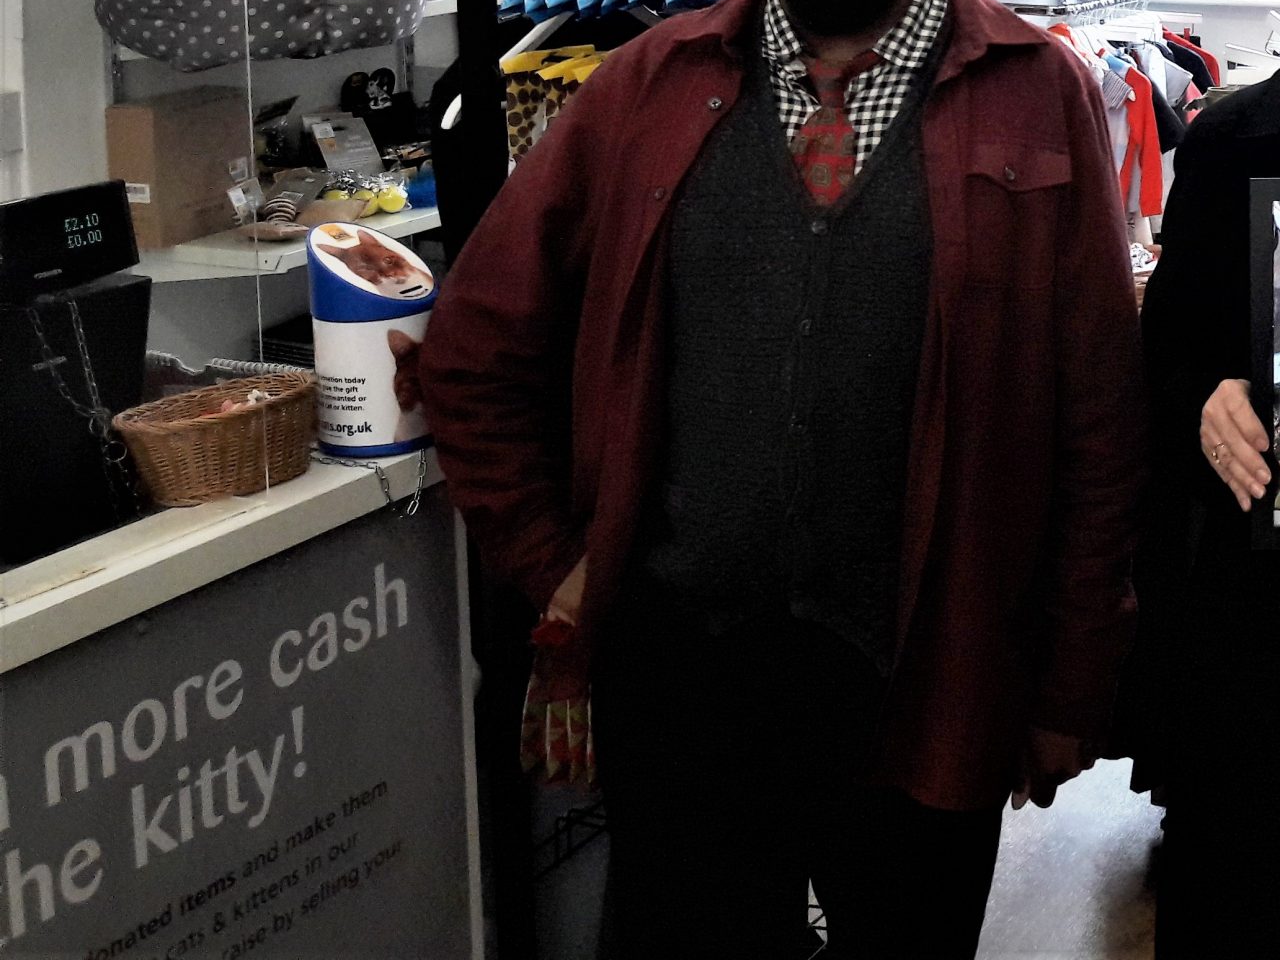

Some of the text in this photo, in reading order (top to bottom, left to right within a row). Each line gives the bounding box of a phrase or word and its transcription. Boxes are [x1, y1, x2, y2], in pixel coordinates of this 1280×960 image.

[65, 213, 98, 232] £2.10
[68, 230, 102, 248] £0.00
[344, 376, 366, 385] today
[345, 386, 359, 394] gift
[44, 658, 244, 808] more
[269, 562, 408, 689] cash
[0, 838, 104, 940] he
[130, 705, 308, 869] kitty!
[179, 870, 238, 917] items
[242, 841, 280, 880] and
[285, 810, 337, 855] make
[341, 779, 389, 818] them
[212, 912, 227, 934] &
[231, 870, 300, 921] kittens
[304, 854, 322, 876] in
[328, 830, 360, 862] our
[272, 908, 295, 936] by
[299, 872, 360, 918] selling
